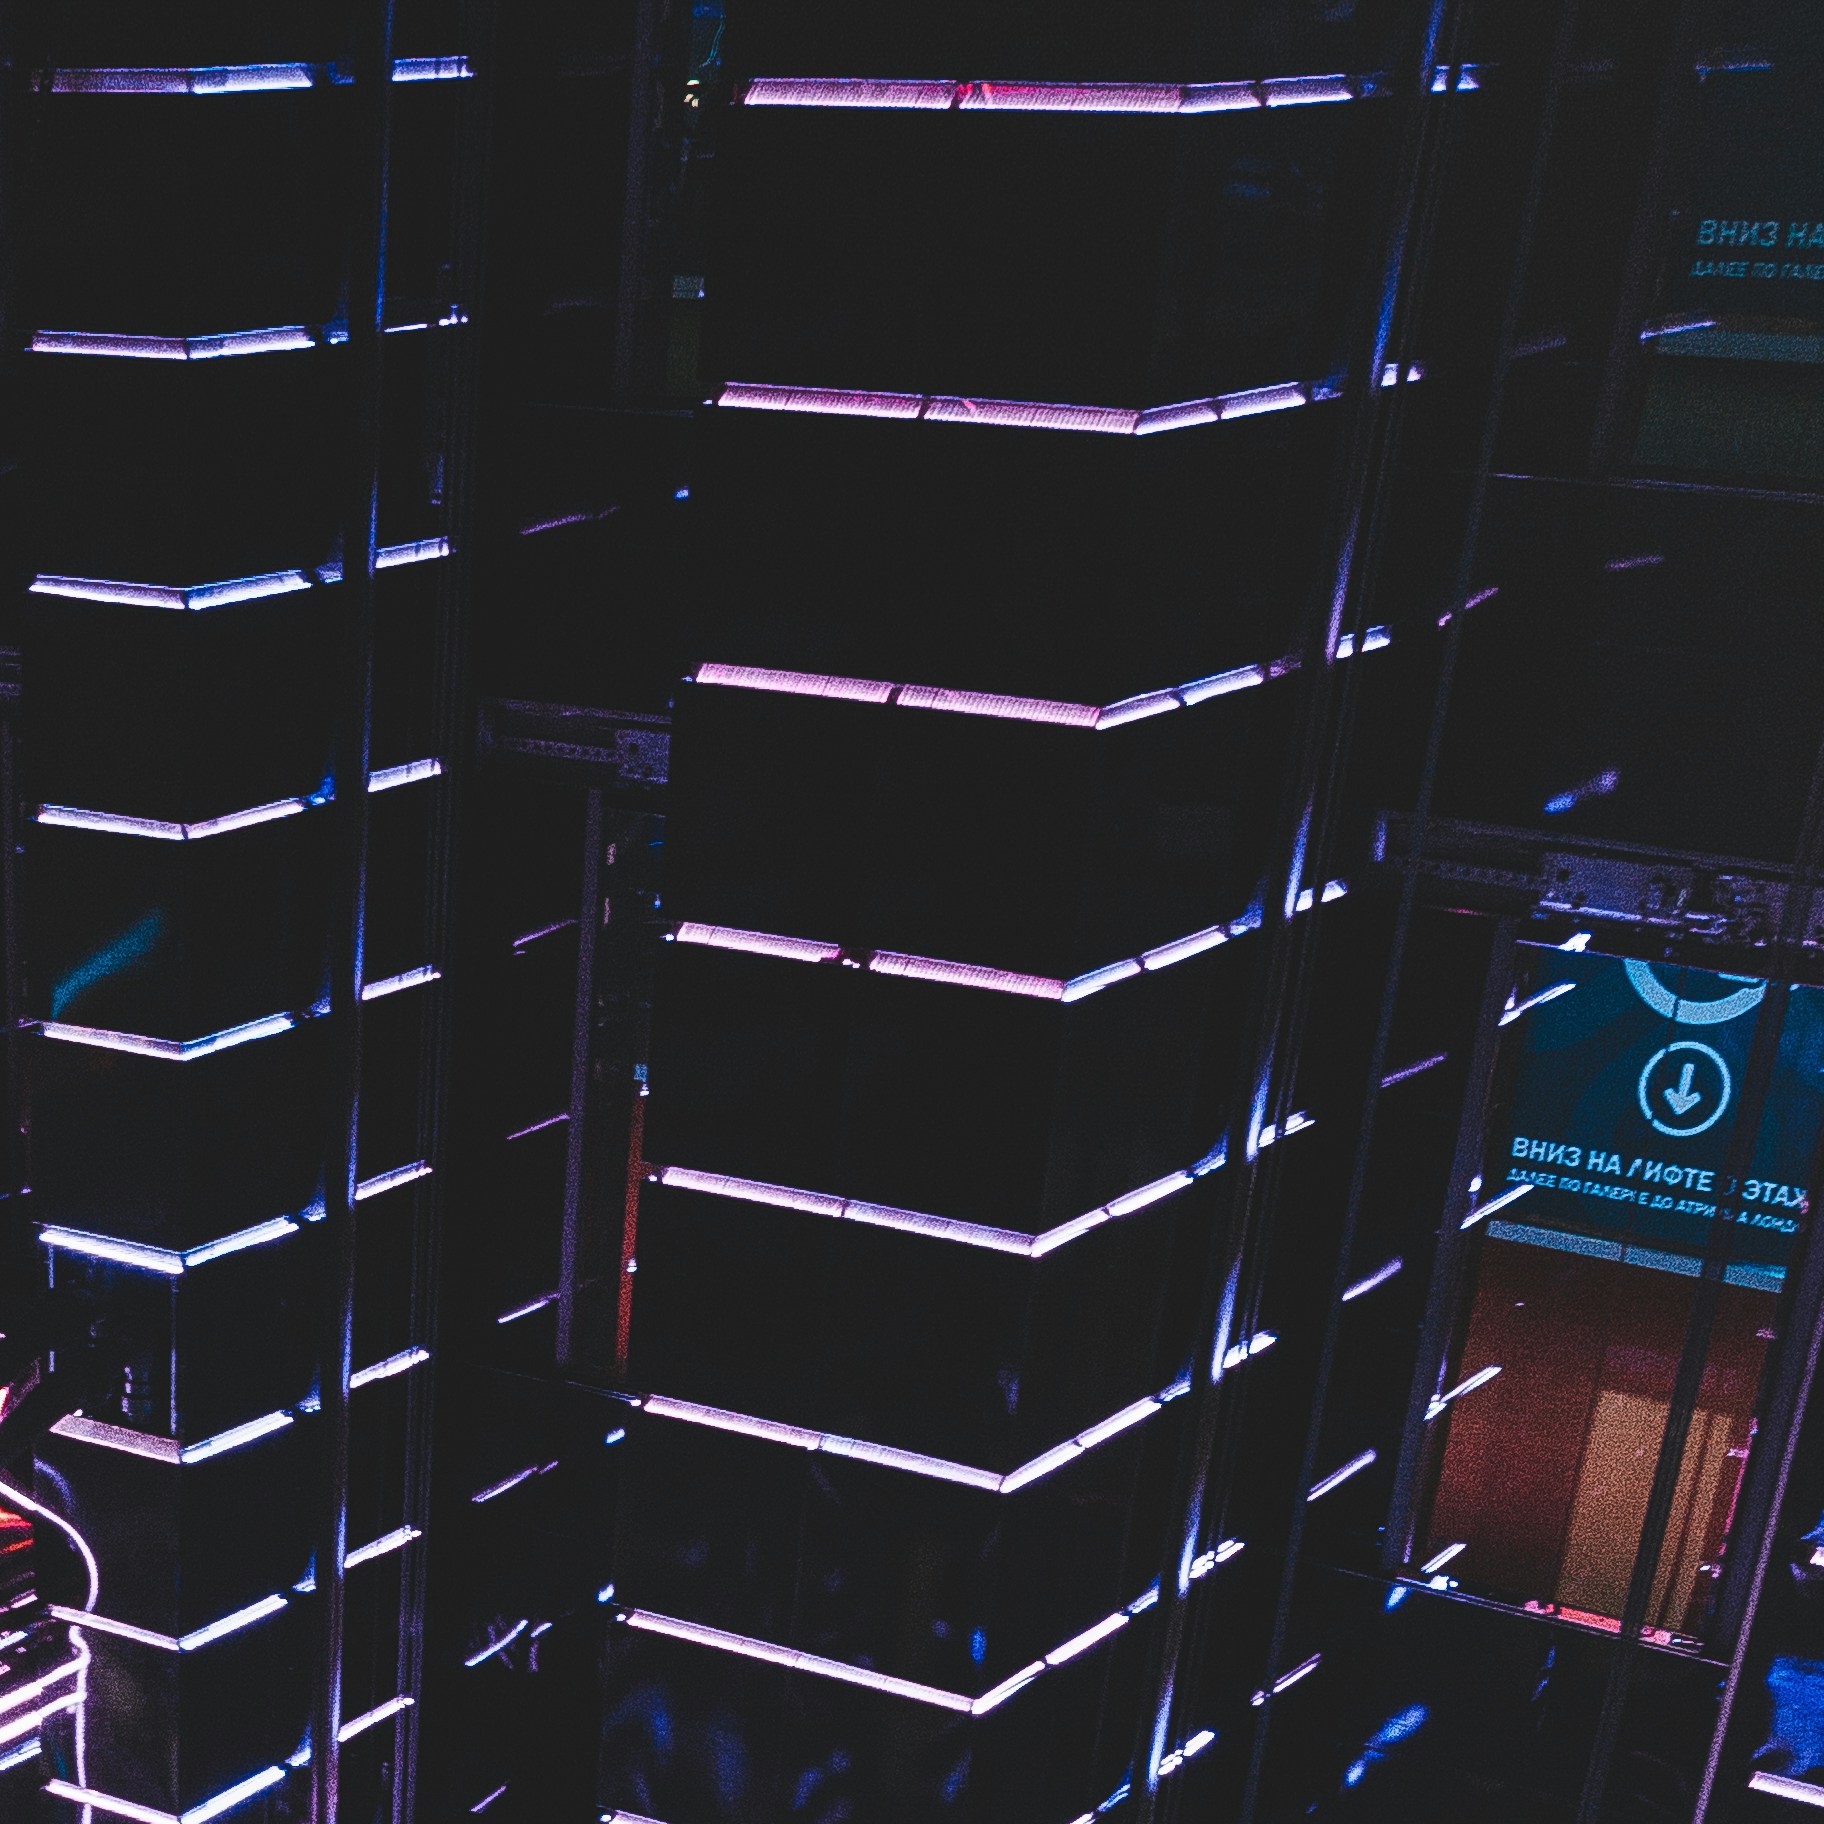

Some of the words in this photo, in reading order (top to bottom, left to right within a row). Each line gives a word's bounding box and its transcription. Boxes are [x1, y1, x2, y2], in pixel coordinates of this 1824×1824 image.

[1696, 219, 1779, 247] ВНИЗ
[1510, 1136, 1582, 1168] ВНИЗ
[1586, 1150, 1622, 1176] НА
